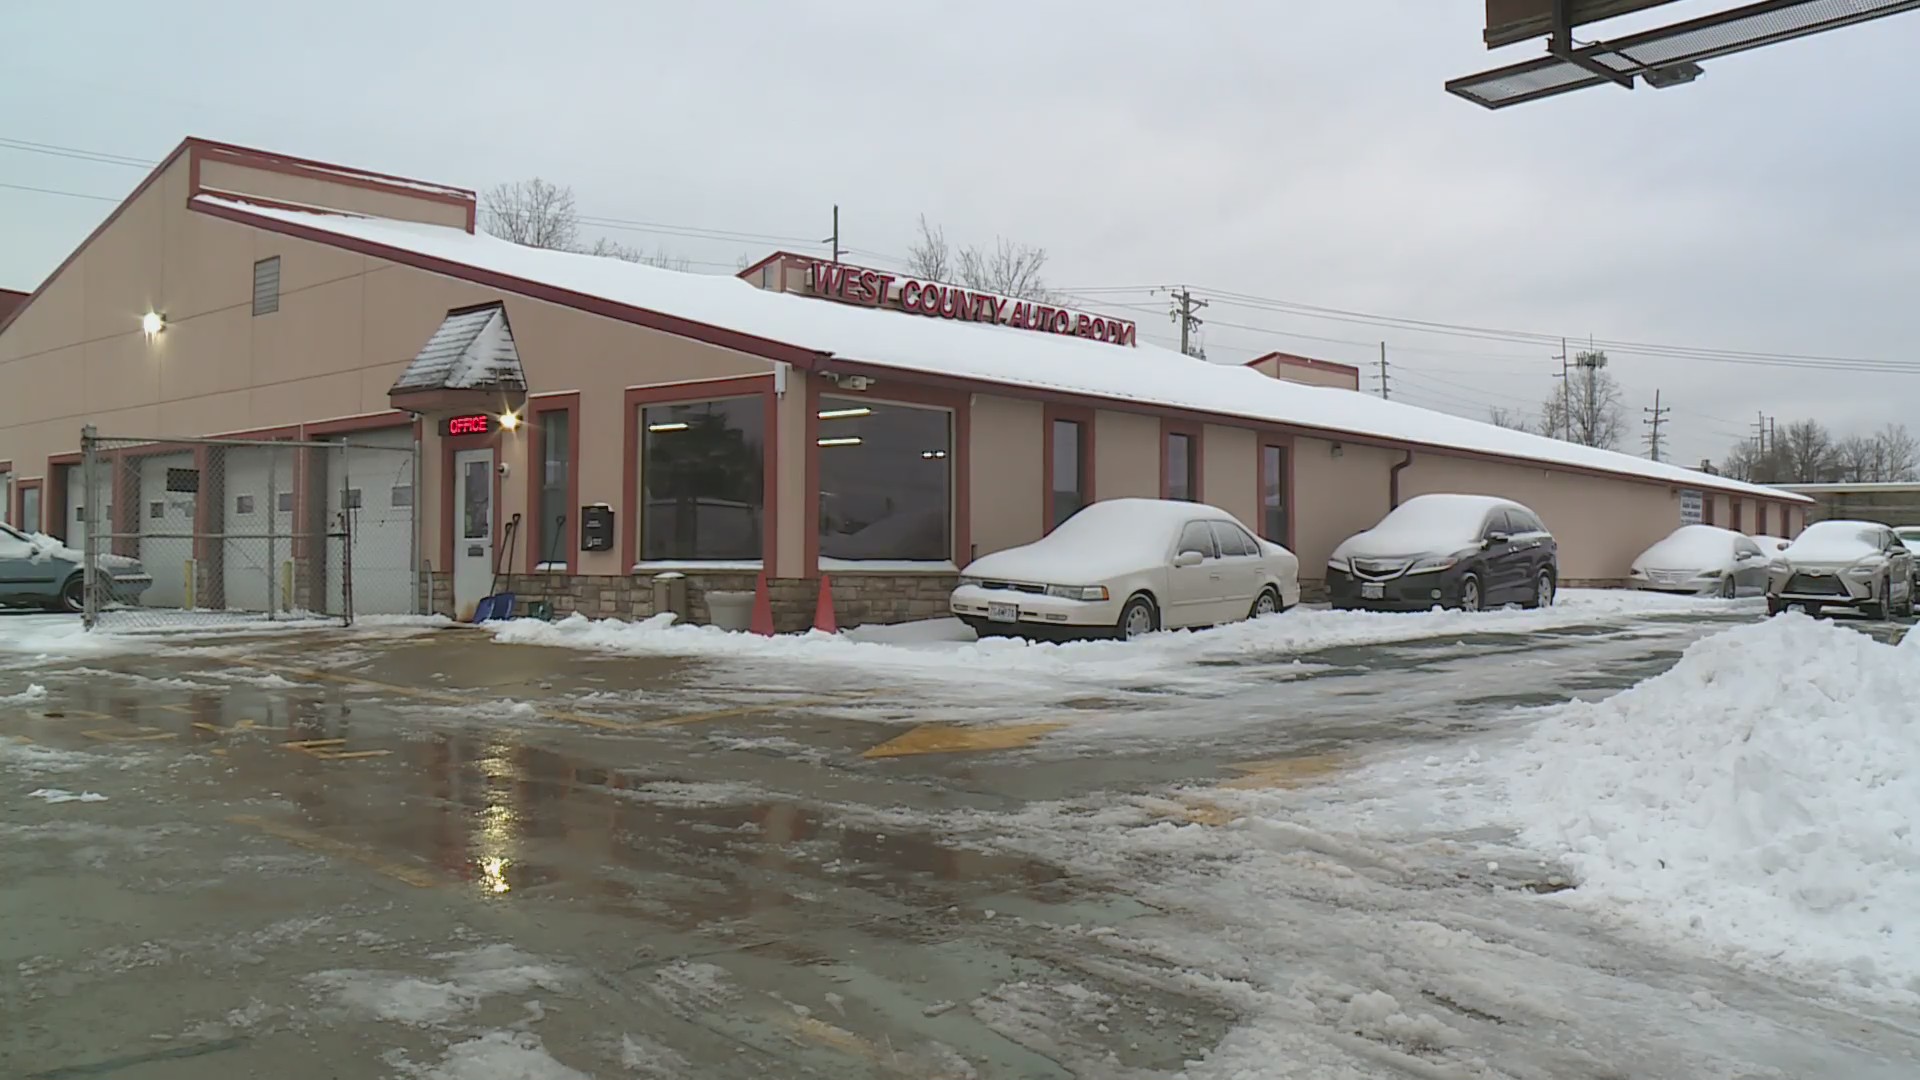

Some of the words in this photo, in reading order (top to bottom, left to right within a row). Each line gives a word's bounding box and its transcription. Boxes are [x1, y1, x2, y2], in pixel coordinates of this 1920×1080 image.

[812, 262, 895, 305] WEST
[901, 280, 1007, 324] COUNTY
[1011, 301, 1069, 334] AUTO
[450, 415, 487, 434] OFFICE
